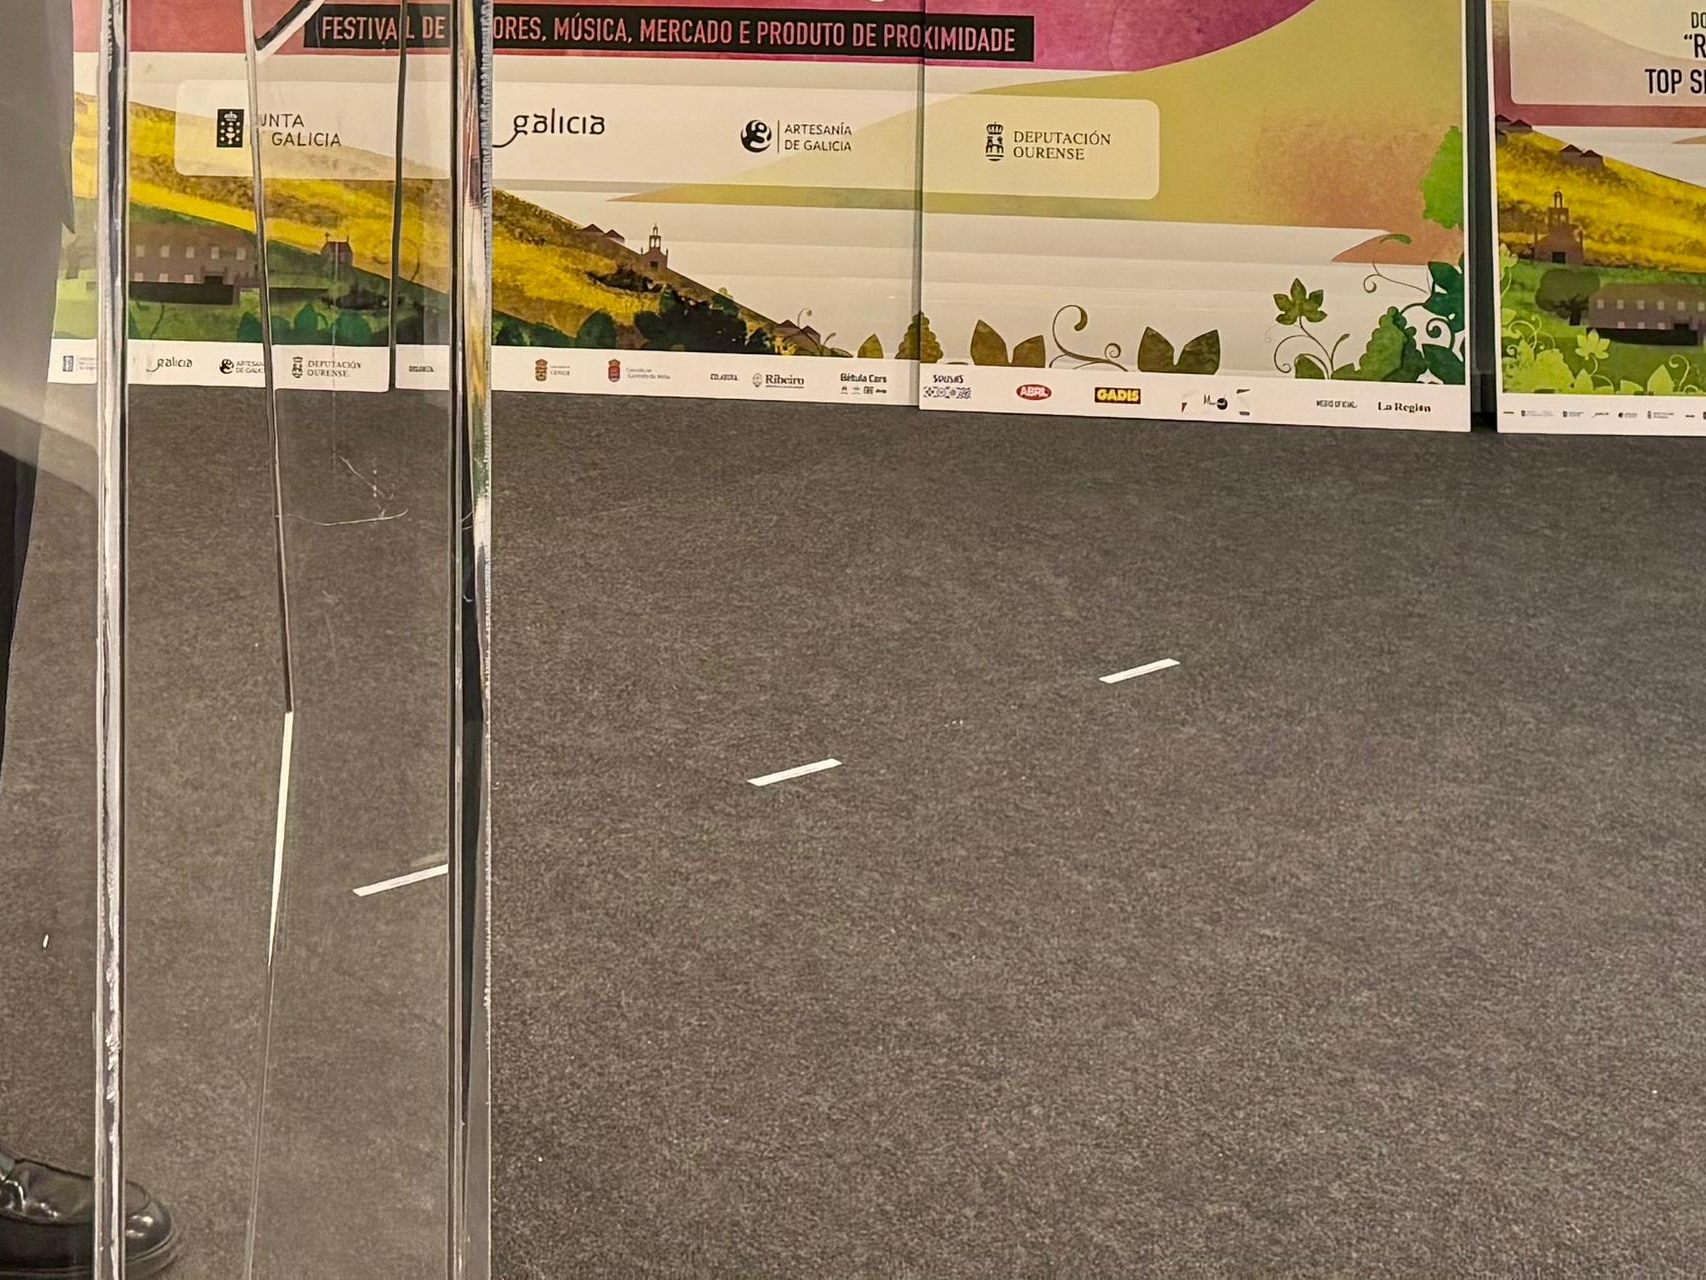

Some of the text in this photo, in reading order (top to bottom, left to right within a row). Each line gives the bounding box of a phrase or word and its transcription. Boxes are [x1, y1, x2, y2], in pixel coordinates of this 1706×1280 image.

[322, 12, 1015, 52] FESTIVAL DE ORES, MÚSICA, MERCADO E PRODUTO DE PROXIMIDADE
[1645, 69, 1683, 95] TOP
[261, 113, 304, 128] UNTA
[492, 107, 605, 148] galicia
[784, 120, 852, 136] ARTESANÍA
[272, 132, 341, 146] GALICIA
[1013, 130, 1111, 145] DEPUTACIÓN
[784, 140, 852, 152] DE GALICIA
[1013, 146, 1085, 160] OURENSE
[765, 374, 804, 386] Ribeiro
[1096, 389, 1139, 402] GADIS
